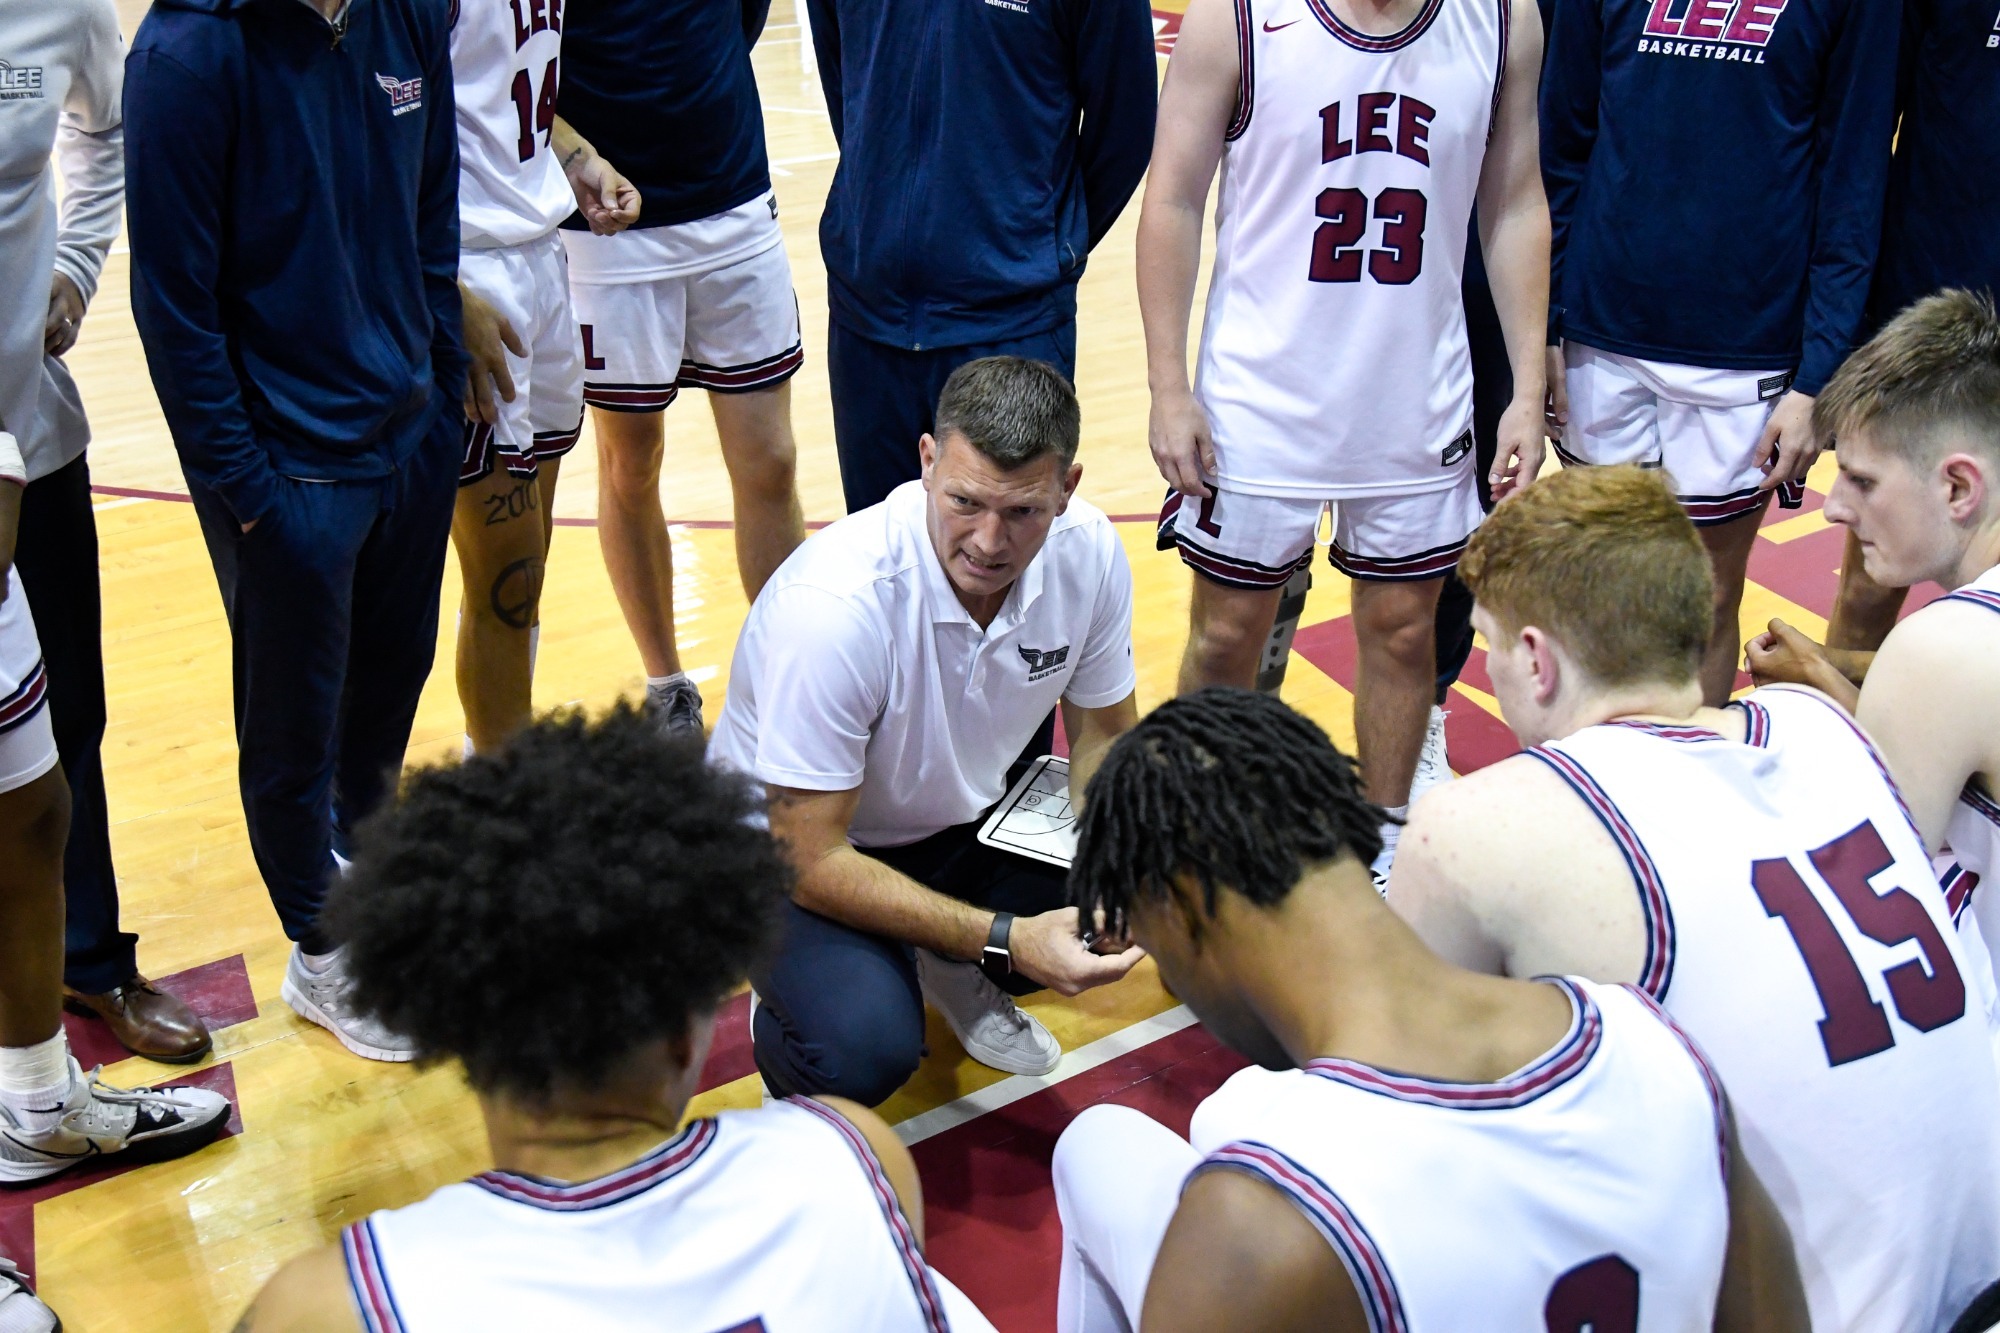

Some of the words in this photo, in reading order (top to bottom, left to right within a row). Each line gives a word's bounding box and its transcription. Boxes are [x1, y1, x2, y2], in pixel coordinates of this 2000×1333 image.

[1642, 0, 1789, 47] LEE
[1637, 39, 1766, 64] BASKETBALL
[0, 67, 43, 90] LEE
[391, 77, 422, 107] LEE
[511, 56, 558, 163] 14
[1319, 92, 1436, 168] LEE
[1308, 187, 1428, 285] 23
[580, 323, 606, 370] L
[1195, 480, 1222, 539] L
[1029, 645, 1070, 674] LEE
[1751, 818, 1966, 1068] 15
